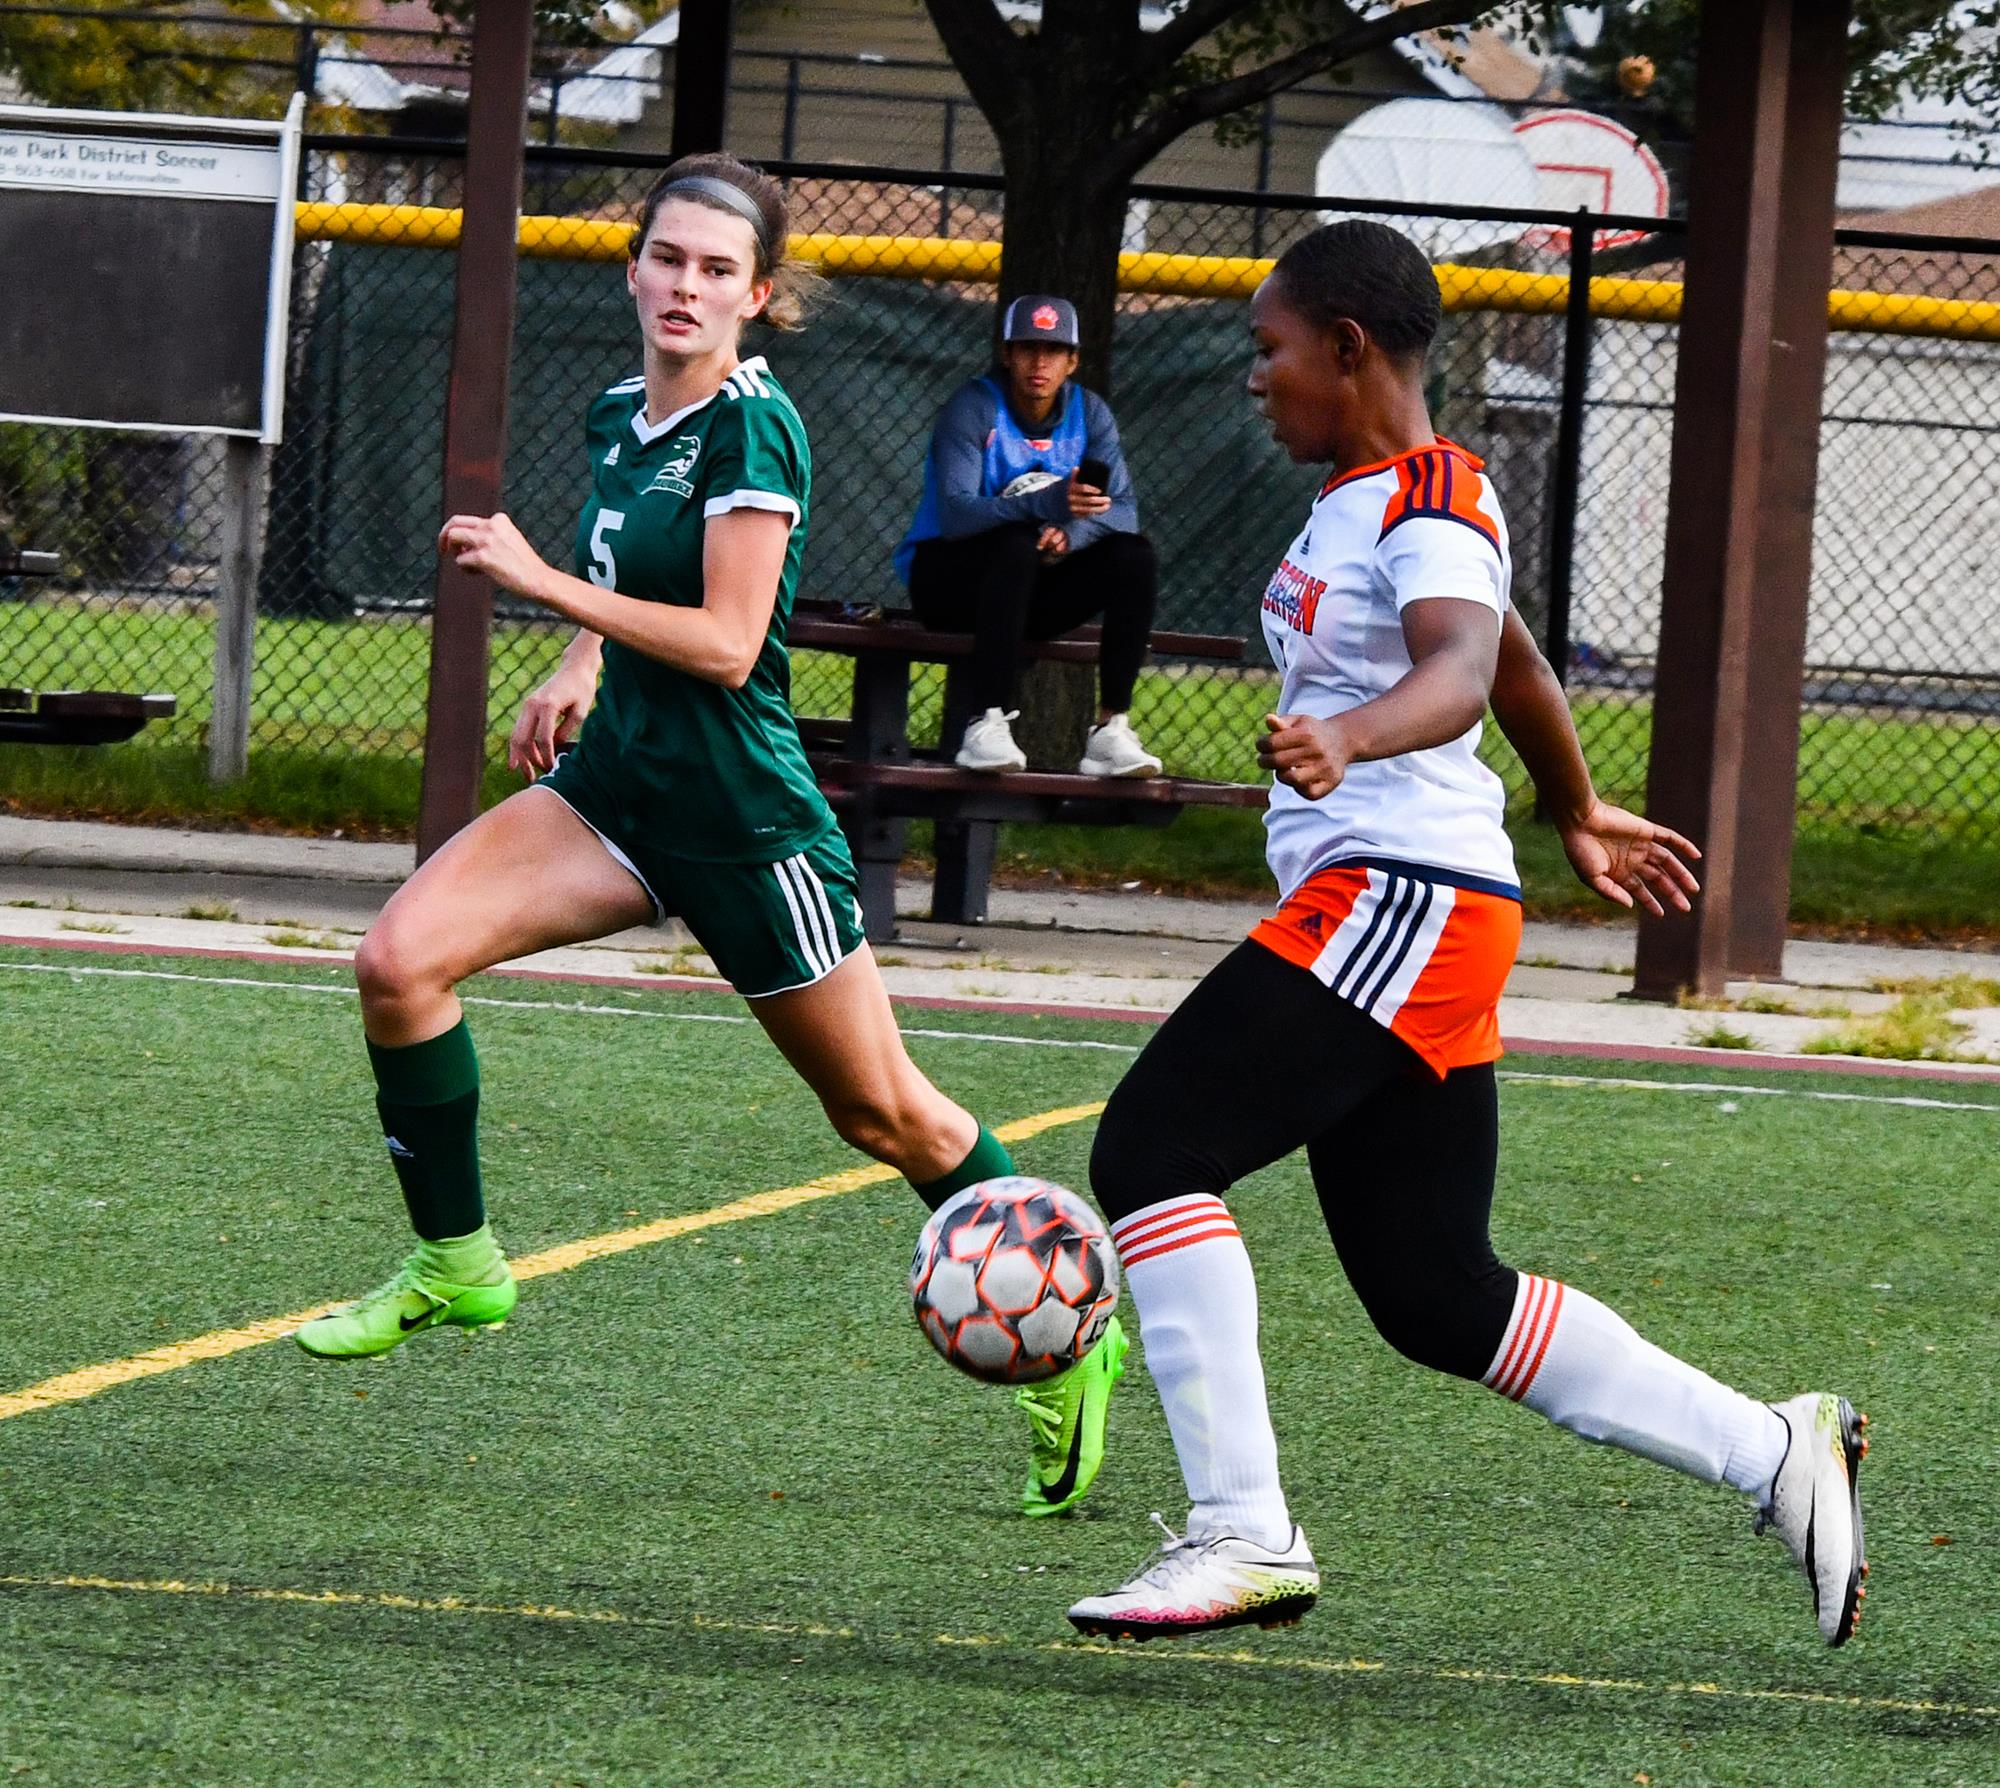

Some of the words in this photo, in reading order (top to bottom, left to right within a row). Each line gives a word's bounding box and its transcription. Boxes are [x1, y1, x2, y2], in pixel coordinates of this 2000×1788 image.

[27, 142, 68, 160] Park
[78, 145, 147, 166] District
[156, 149, 217, 171] Soccer
[588, 507, 626, 592] 5
